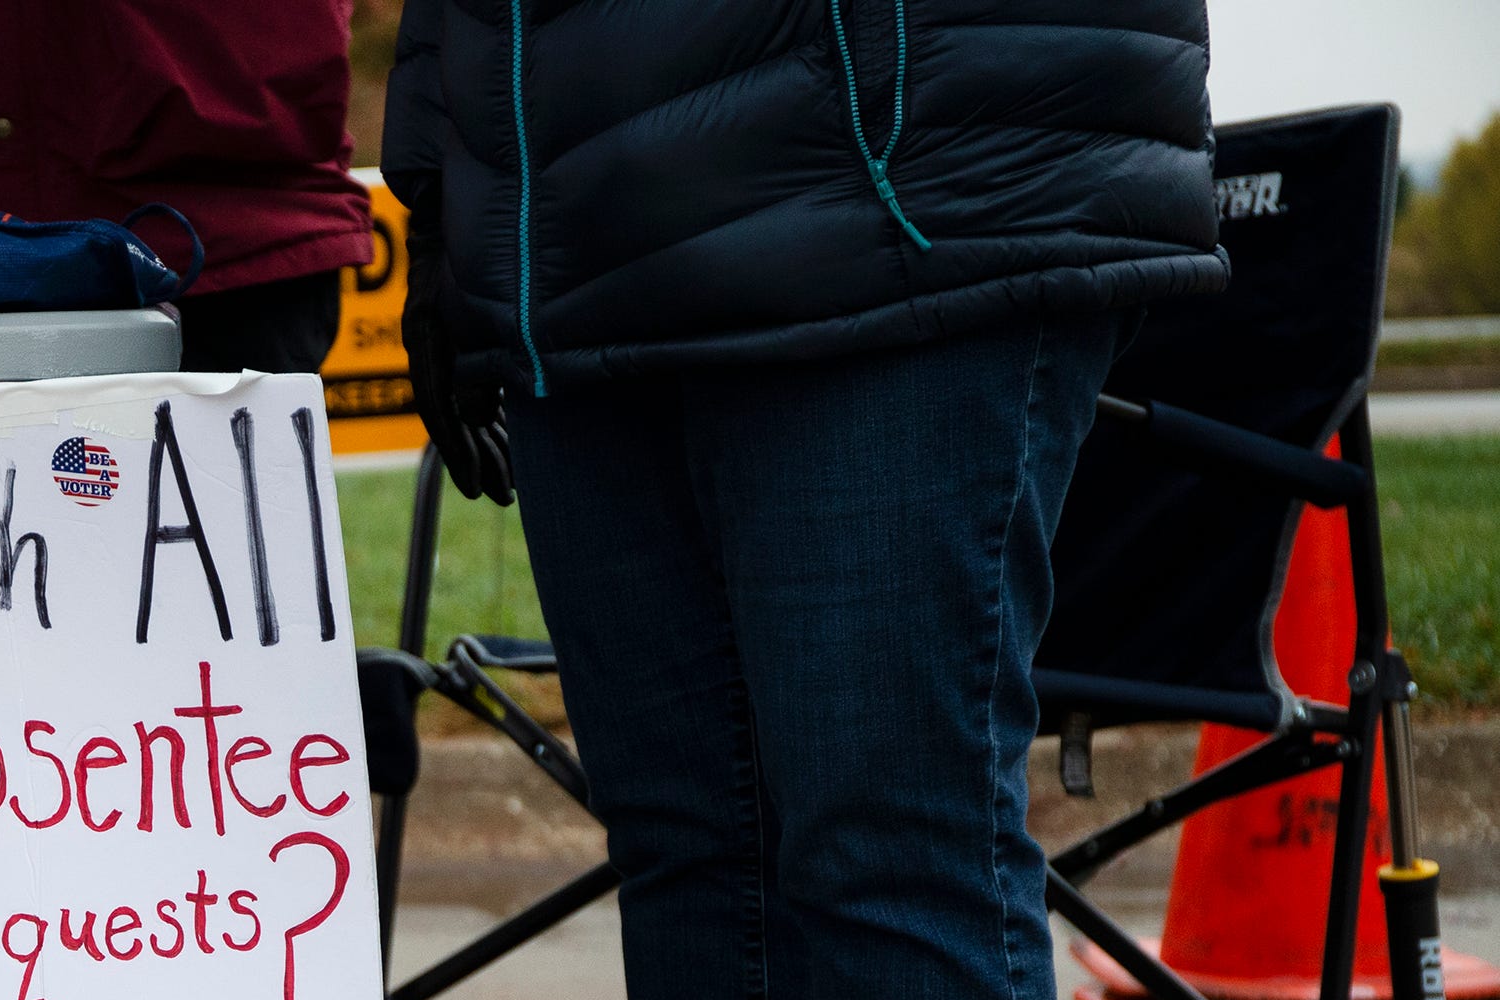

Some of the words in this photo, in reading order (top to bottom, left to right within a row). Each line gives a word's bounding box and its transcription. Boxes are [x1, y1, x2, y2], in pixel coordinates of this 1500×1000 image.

[89, 453, 110, 466] BE
[99, 470, 112, 482] A
[60, 480, 113, 497] VOTER
[136, 400, 336, 647] All
